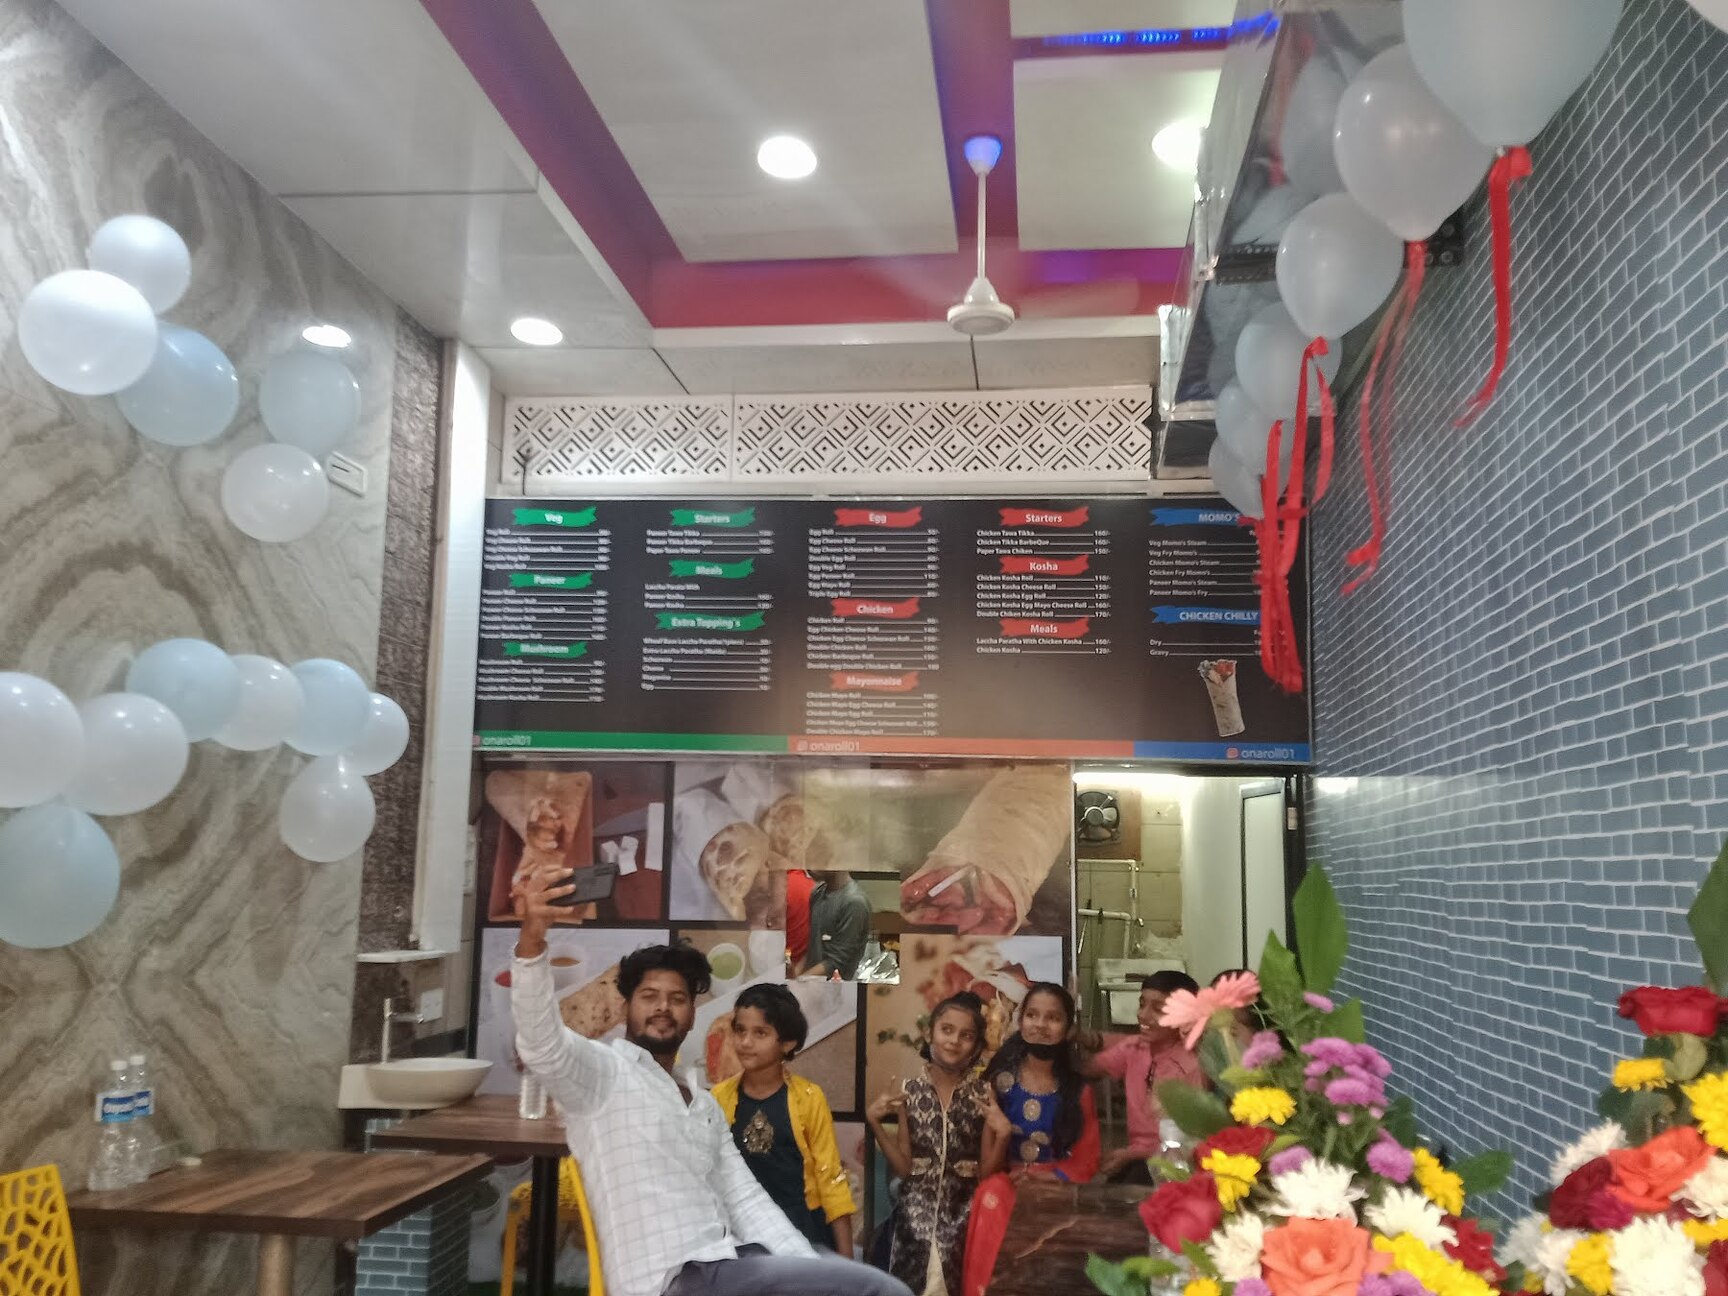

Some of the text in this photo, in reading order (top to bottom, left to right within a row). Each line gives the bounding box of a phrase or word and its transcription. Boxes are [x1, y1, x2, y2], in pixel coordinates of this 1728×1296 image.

[694, 514, 730, 523] Starters
[869, 514, 887, 524] Egg
[1026, 514, 1062, 522] Starters
[1030, 562, 1058, 570] Kosha
[1175, 570, 1185, 578] Fry
[1198, 590, 1208, 598] Fry
[857, 605, 893, 614] Chicken
[1180, 612, 1258, 620] CHICKEN CHILLY
[1030, 624, 1058, 633] Meals
[847, 676, 902, 687] Mayonnaise
[482, 736, 531, 745] onaroll01
[810, 742, 860, 751] onaroll01
[1241, 749, 1294, 758] onaroll01
